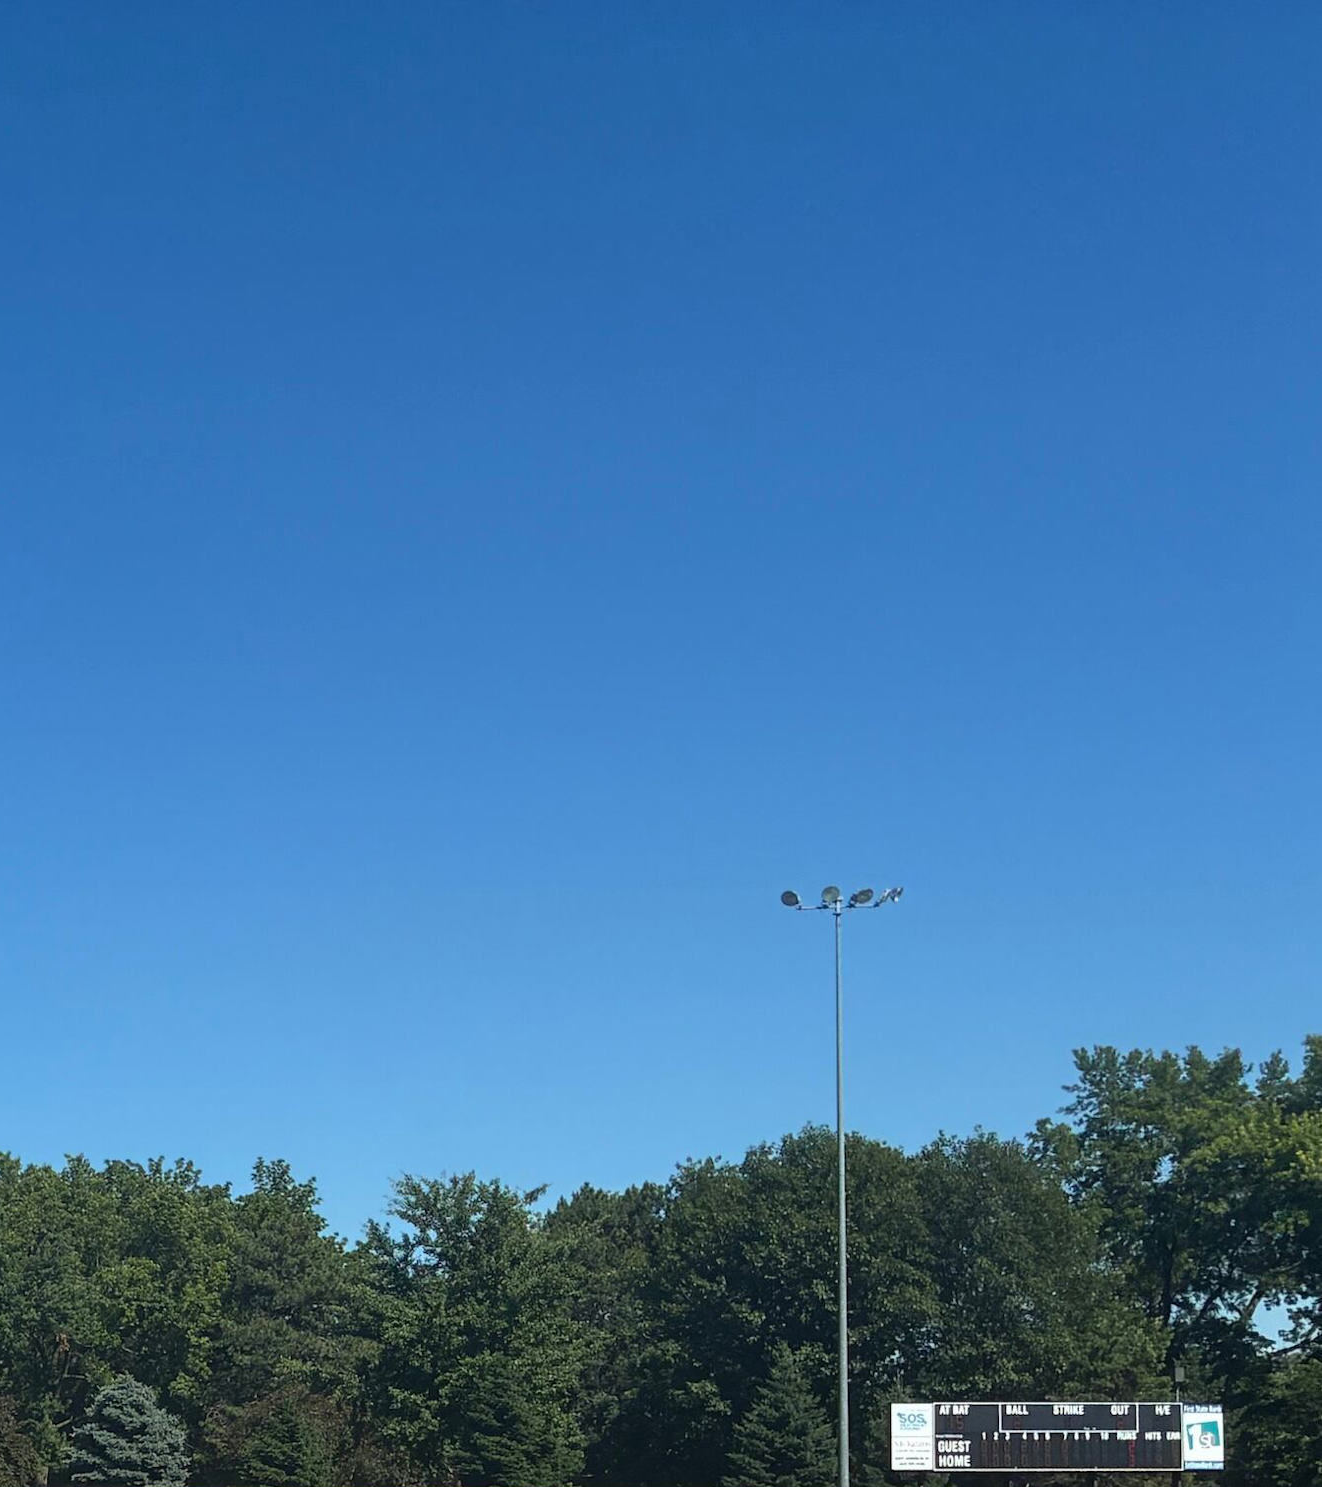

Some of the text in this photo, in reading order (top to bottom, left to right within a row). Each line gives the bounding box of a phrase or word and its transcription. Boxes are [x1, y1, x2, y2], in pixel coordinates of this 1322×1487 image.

[939, 1405, 970, 1415] AT BAT
[1005, 1405, 1029, 1415] BALL
[1052, 1405, 1085, 1415] STRIKE
[1110, 1405, 1130, 1415] OUT
[937, 1440, 971, 1453] GUEST
[938, 1455, 971, 1467] HOME
